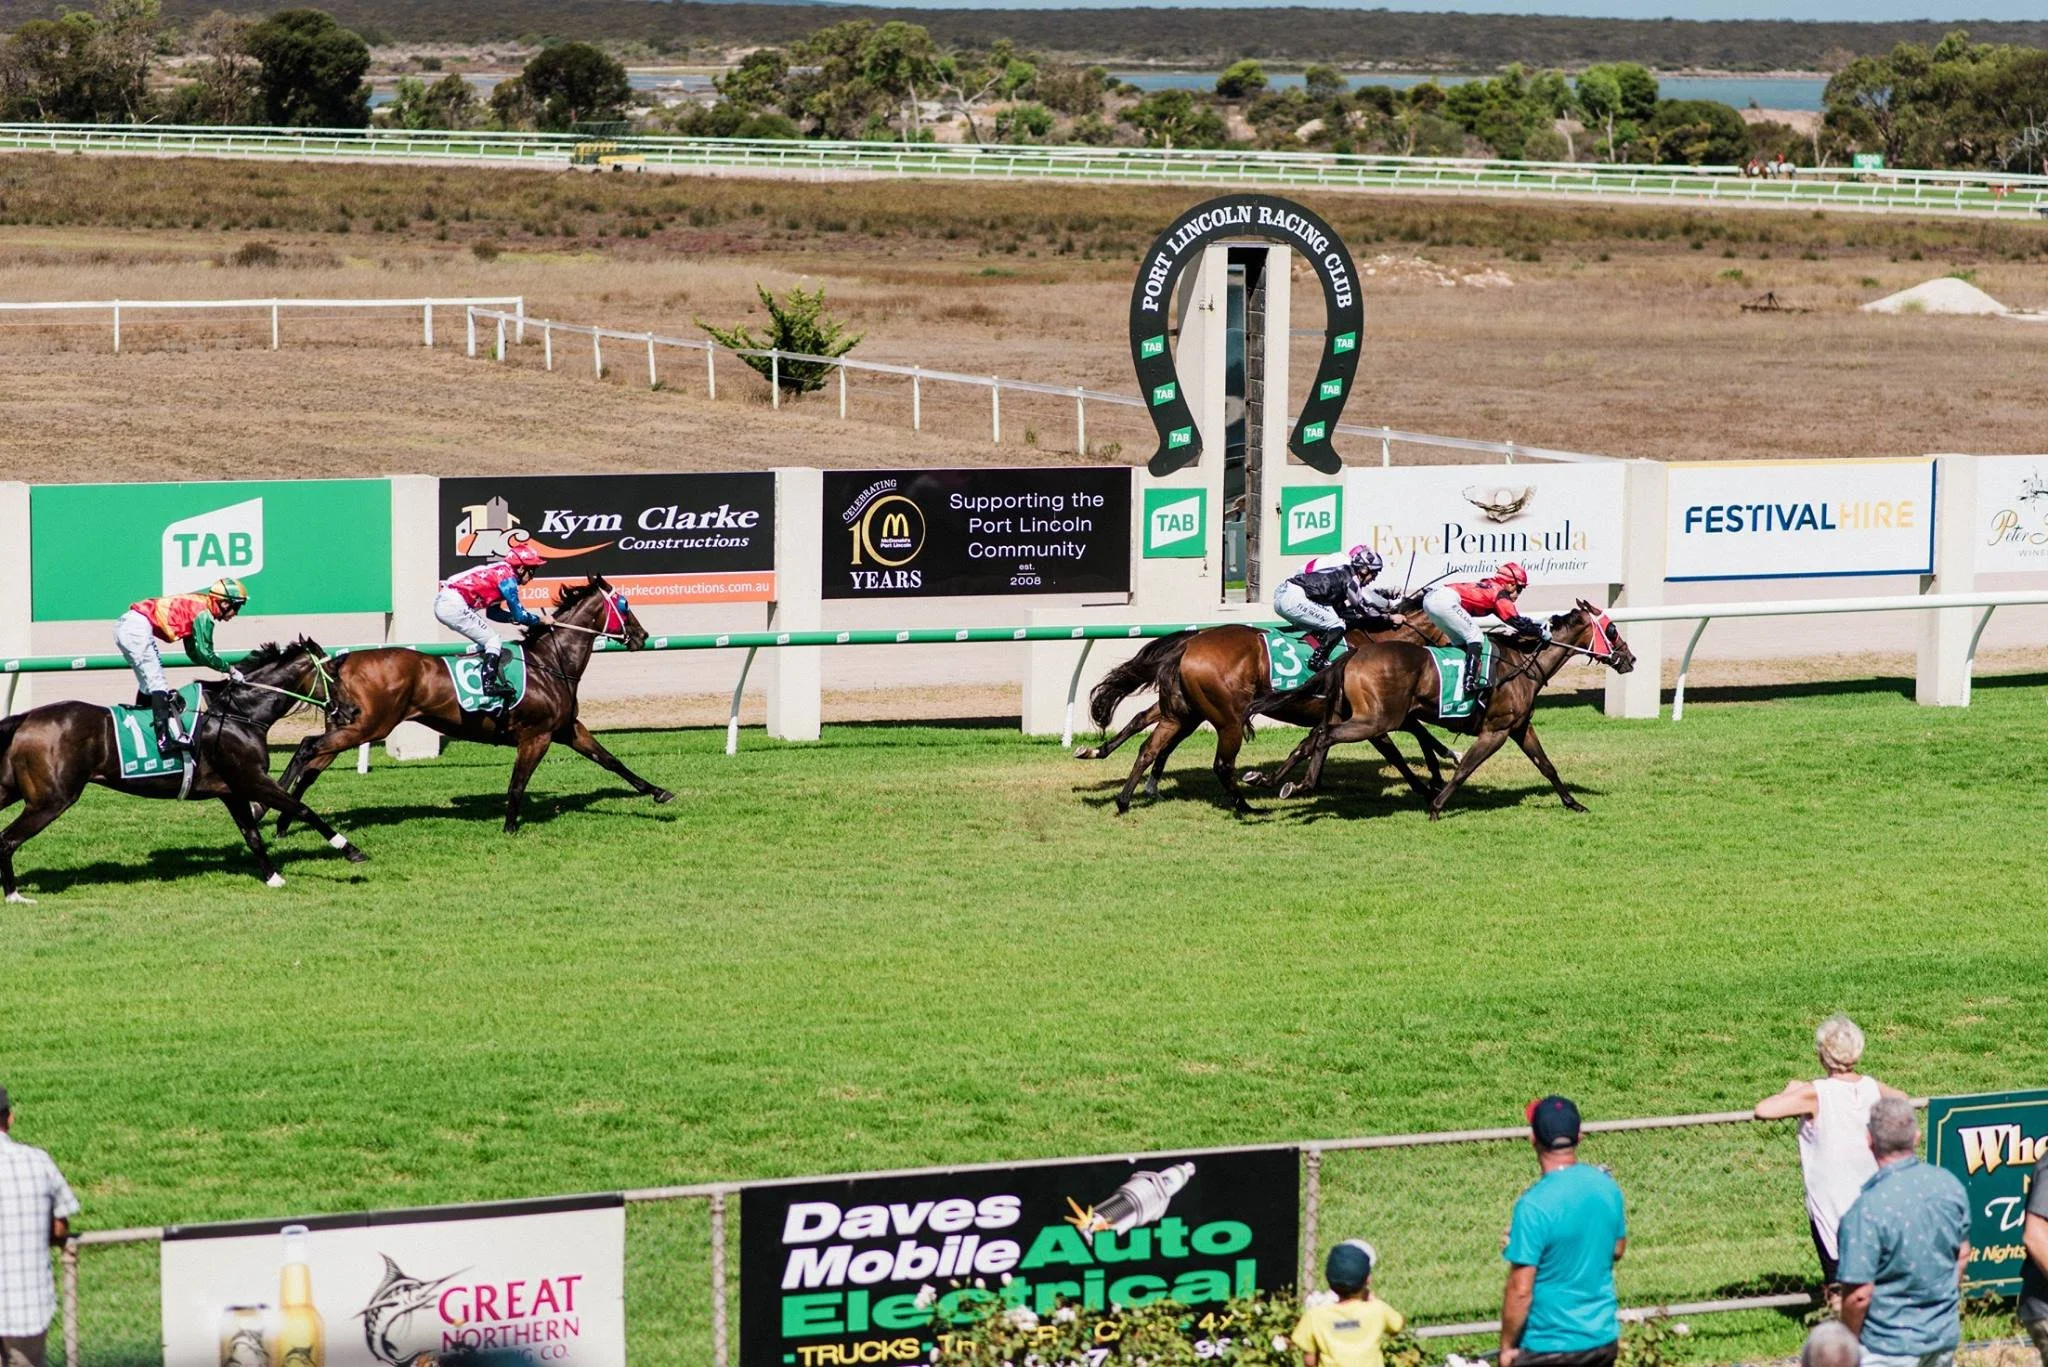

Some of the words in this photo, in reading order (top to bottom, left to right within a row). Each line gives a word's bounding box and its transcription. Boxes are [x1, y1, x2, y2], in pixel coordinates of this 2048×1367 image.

[1142, 252, 1173, 312] PORT
[1167, 205, 1253, 255] LINCOLN
[1258, 206, 1330, 254] RACING
[1324, 253, 1352, 309] CLUB
[1144, 341, 1162, 353] TAB
[1337, 338, 1354, 349] TAB
[1156, 389, 1174, 400] TAB
[1322, 384, 1340, 395] TAB
[1171, 432, 1190, 444] TAB
[1306, 427, 1323, 438] TAB
[842, 479, 898, 521] CELEBRATING
[950, 493, 1064, 512] Supporting
[1072, 492, 1104, 507] the
[538, 510, 623, 539] Kym
[638, 503, 760, 531] Clarke
[969, 518, 1012, 533] Port
[1020, 516, 1092, 532] Lincoln
[1156, 513, 1194, 532] TAB
[1294, 511, 1331, 529] TAB
[173, 532, 252, 567] TAB
[618, 534, 750, 551] Constructions
[968, 541, 1086, 559] Community
[2018, 549, 2048, 557] WINE
[1545, 558, 1589, 575] frontier
[849, 570, 922, 589] YEARS
[1009, 577, 1042, 586] 2008
[521, 586, 550, 600] 1208
[614, 581, 770, 597] clarkeconstructions.com.au
[1271, 637, 1303, 677] 3
[456, 658, 484, 695] 6
[1442, 659, 1466, 701] 7
[123, 715, 148, 758] 1
[781, 1195, 1021, 1245] Daves
[1018, 1217, 1253, 1270] Auto
[781, 1234, 1021, 1289] Mobile
[438, 1273, 583, 1325] GREAT
[781, 1258, 1257, 1338] Electrical
[442, 1317, 580, 1353] NORTHERN
[797, 1337, 920, 1367] TRUCKS
